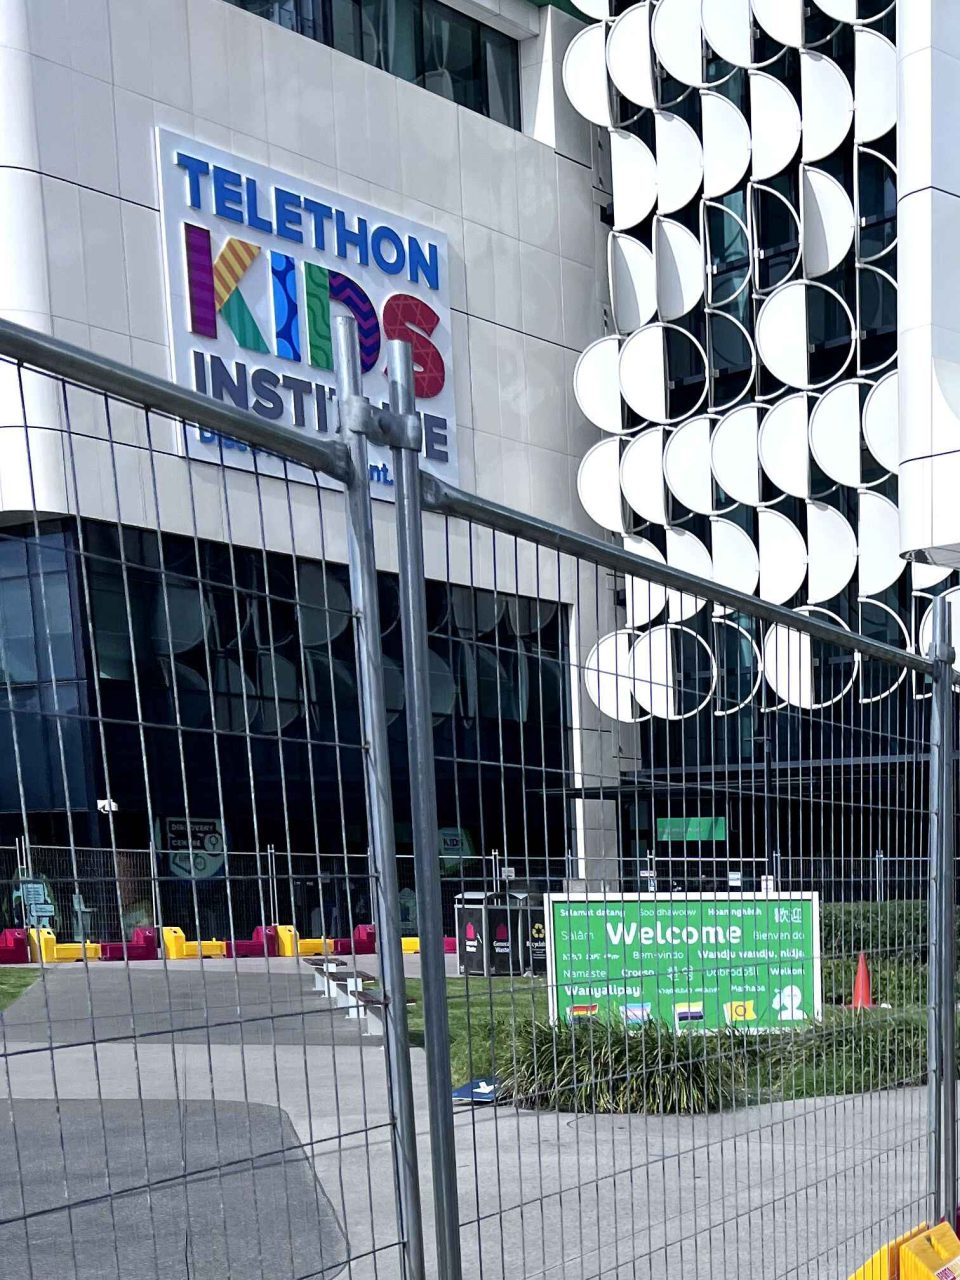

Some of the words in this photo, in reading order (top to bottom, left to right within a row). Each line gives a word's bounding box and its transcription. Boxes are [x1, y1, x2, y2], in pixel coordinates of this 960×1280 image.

[175, 151, 439, 291] TELETHON
[183, 221, 446, 399] KIDS
[192, 349, 449, 463] INSTIE
[171, 823, 214, 832] DISOVERY
[606, 921, 743, 945] Welcome
[752, 930, 805, 941] Bienvendo
[563, 968, 607, 979] Namaste
